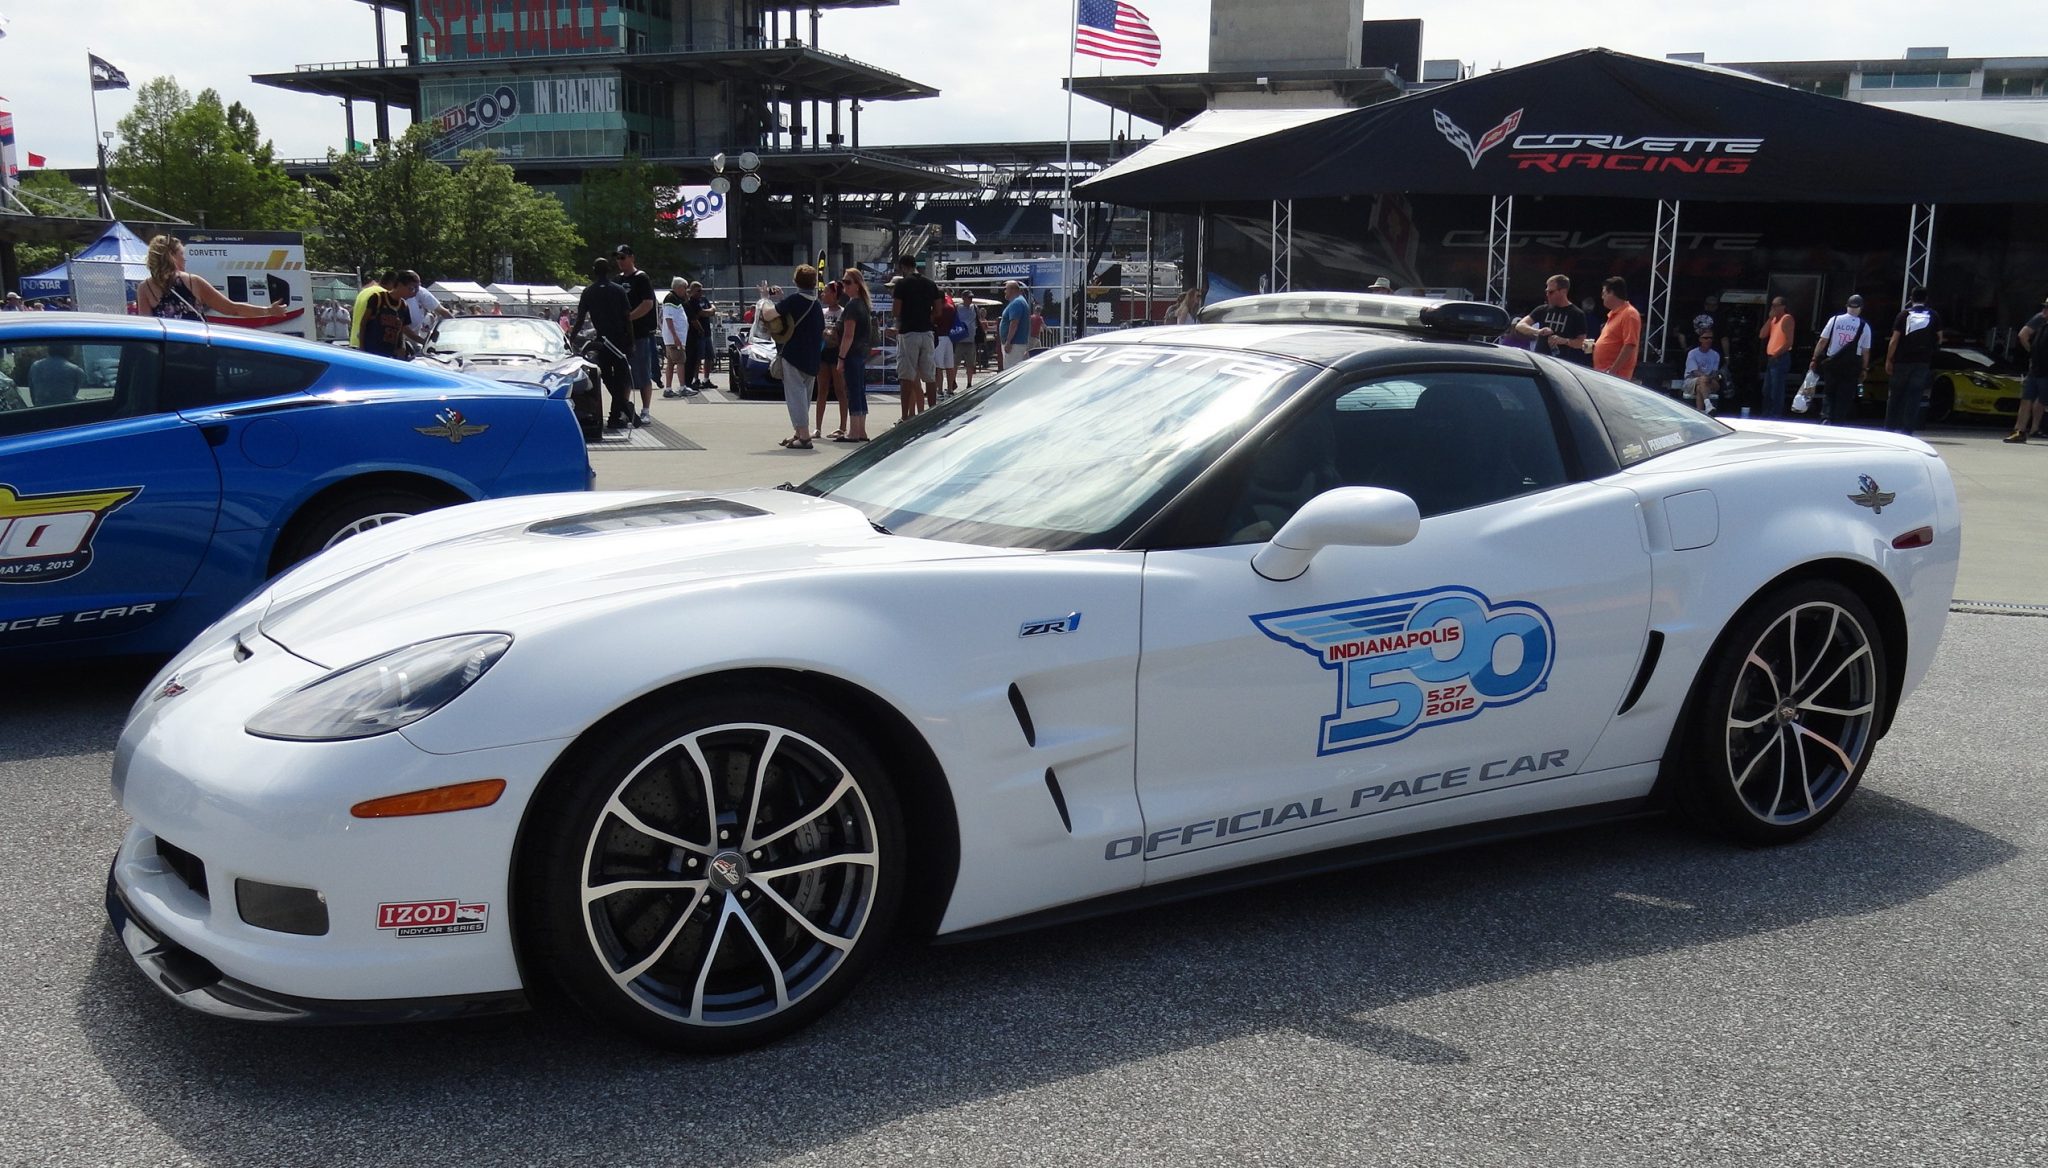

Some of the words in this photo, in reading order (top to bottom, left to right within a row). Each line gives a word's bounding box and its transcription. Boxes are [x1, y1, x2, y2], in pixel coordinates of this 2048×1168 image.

[465, 85, 518, 127] 500
[534, 80, 550, 114] IN
[556, 78, 616, 113] RACING
[1511, 134, 1765, 154] CORVETTE
[1507, 153, 1752, 175] RACING
[188, 249, 228, 257] CORVETTE
[955, 266, 983, 276] OFFICIAL
[983, 264, 1031, 275] MERCHANDISE
[22, 280, 62, 290] INDYSTAR
[25, 563, 42, 573] 26,
[46, 560, 75, 571] 2013
[74, 603, 157, 623] CAR
[1022, 612, 1081, 636] ZR1
[1329, 626, 1460, 661] INDIANAPOLIS
[1328, 597, 1549, 743] 500
[1427, 685, 1468, 702] 5.27
[1426, 697, 1475, 717] 2012
[1104, 797, 1338, 861] OFFICIAL
[1350, 767, 1471, 809] PACE
[1478, 749, 1570, 783] CAR
[384, 904, 451, 924] IZOD
[400, 926, 443, 935] INDYCAR
[446, 924, 482, 932] SERIES
